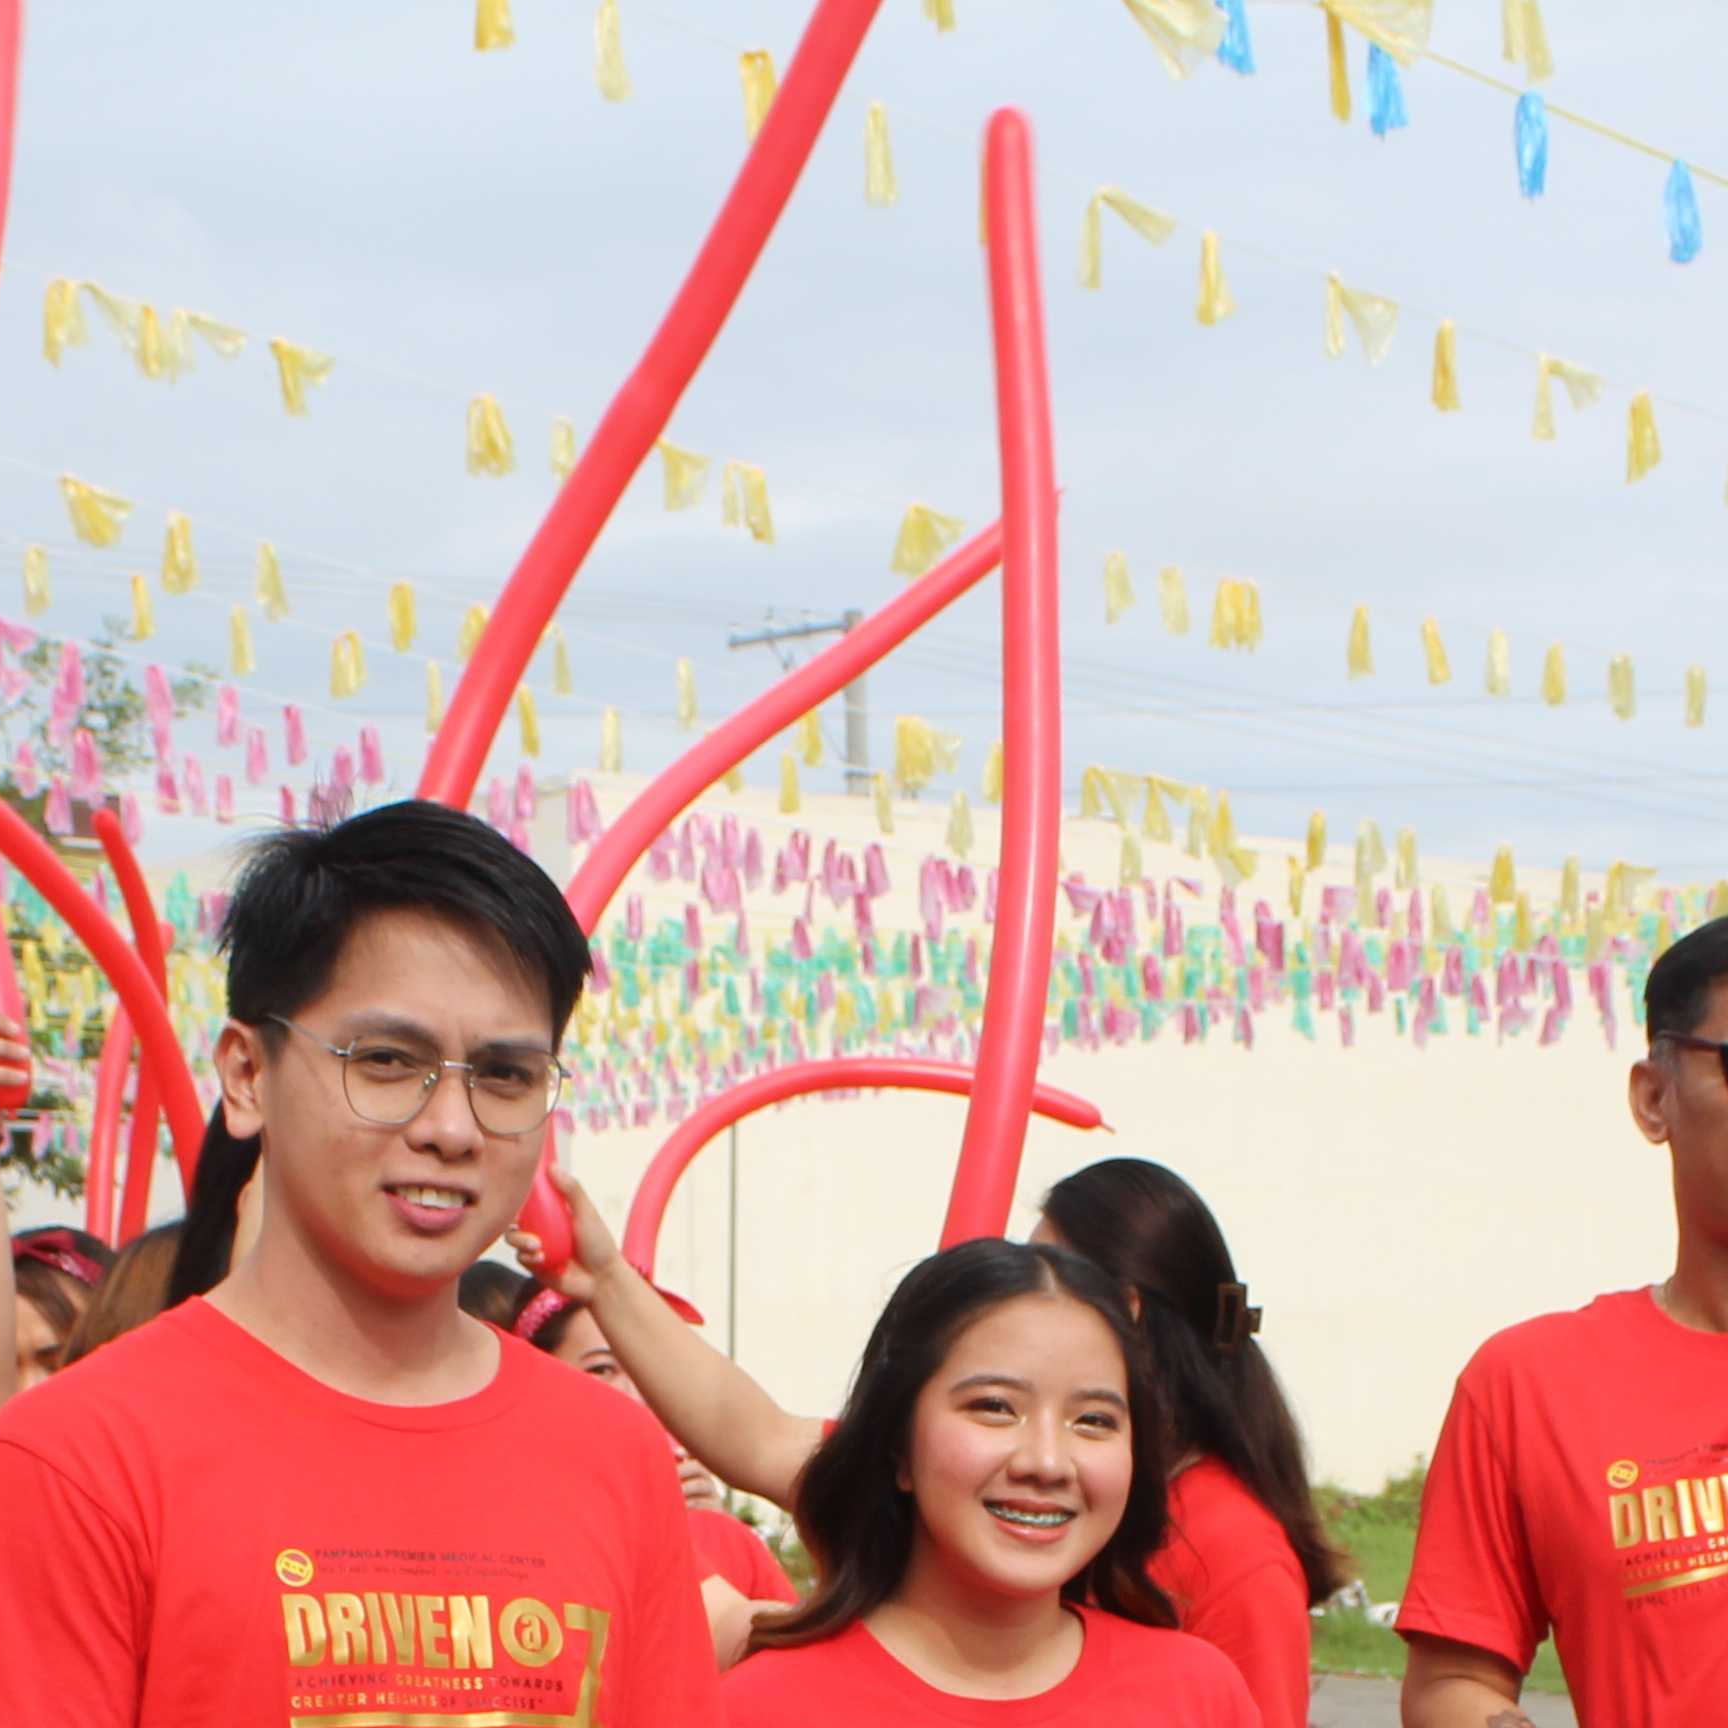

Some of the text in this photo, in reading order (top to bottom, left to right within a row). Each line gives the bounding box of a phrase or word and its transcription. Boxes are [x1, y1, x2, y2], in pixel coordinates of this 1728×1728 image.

[280, 1591, 494, 1670] DRIVEN
[394, 1673, 484, 1691] GREATNESS
[290, 1692, 368, 1710] GREATER
